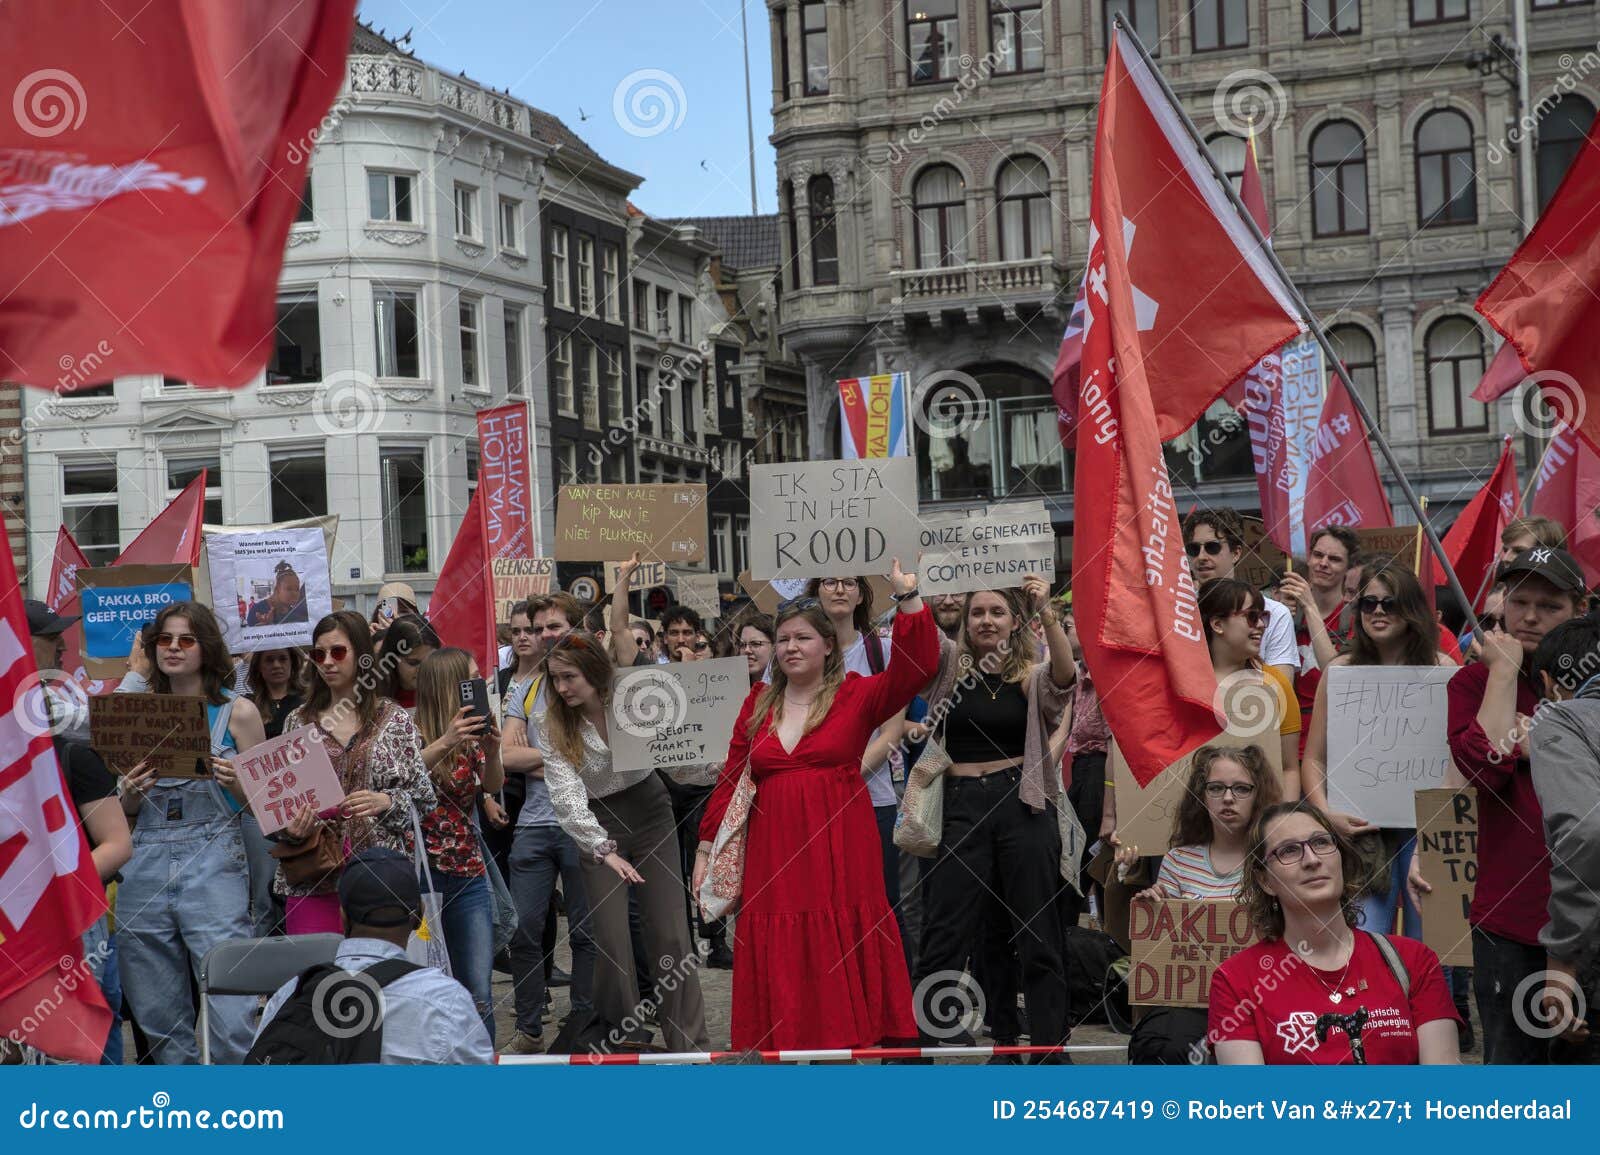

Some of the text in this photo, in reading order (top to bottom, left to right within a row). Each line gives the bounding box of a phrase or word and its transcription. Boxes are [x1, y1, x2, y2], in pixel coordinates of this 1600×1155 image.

[772, 467, 883, 497] IK STA
[568, 488, 657, 501] VAN EEN KALE
[784, 497, 880, 522] IN HET
[920, 522, 1051, 546] ONZE GENERATIE
[774, 526, 886, 569] ROOD
[961, 544, 1000, 557] EIST
[927, 558, 1052, 582] COMPENSATIE
[98, 595, 142, 606] FAKKA
[87, 609, 157, 622] GEEF FLOES
[1336, 680, 1446, 714] #NIET
[646, 739, 693, 752] MAAKT
[1356, 716, 1427, 752] MIJN
[268, 771, 297, 798] SO
[1422, 830, 1477, 854] NIET
[1130, 900, 1253, 944] DAKLO
[1171, 944, 1214, 961] MET
[1135, 961, 1208, 1003] DIPL
